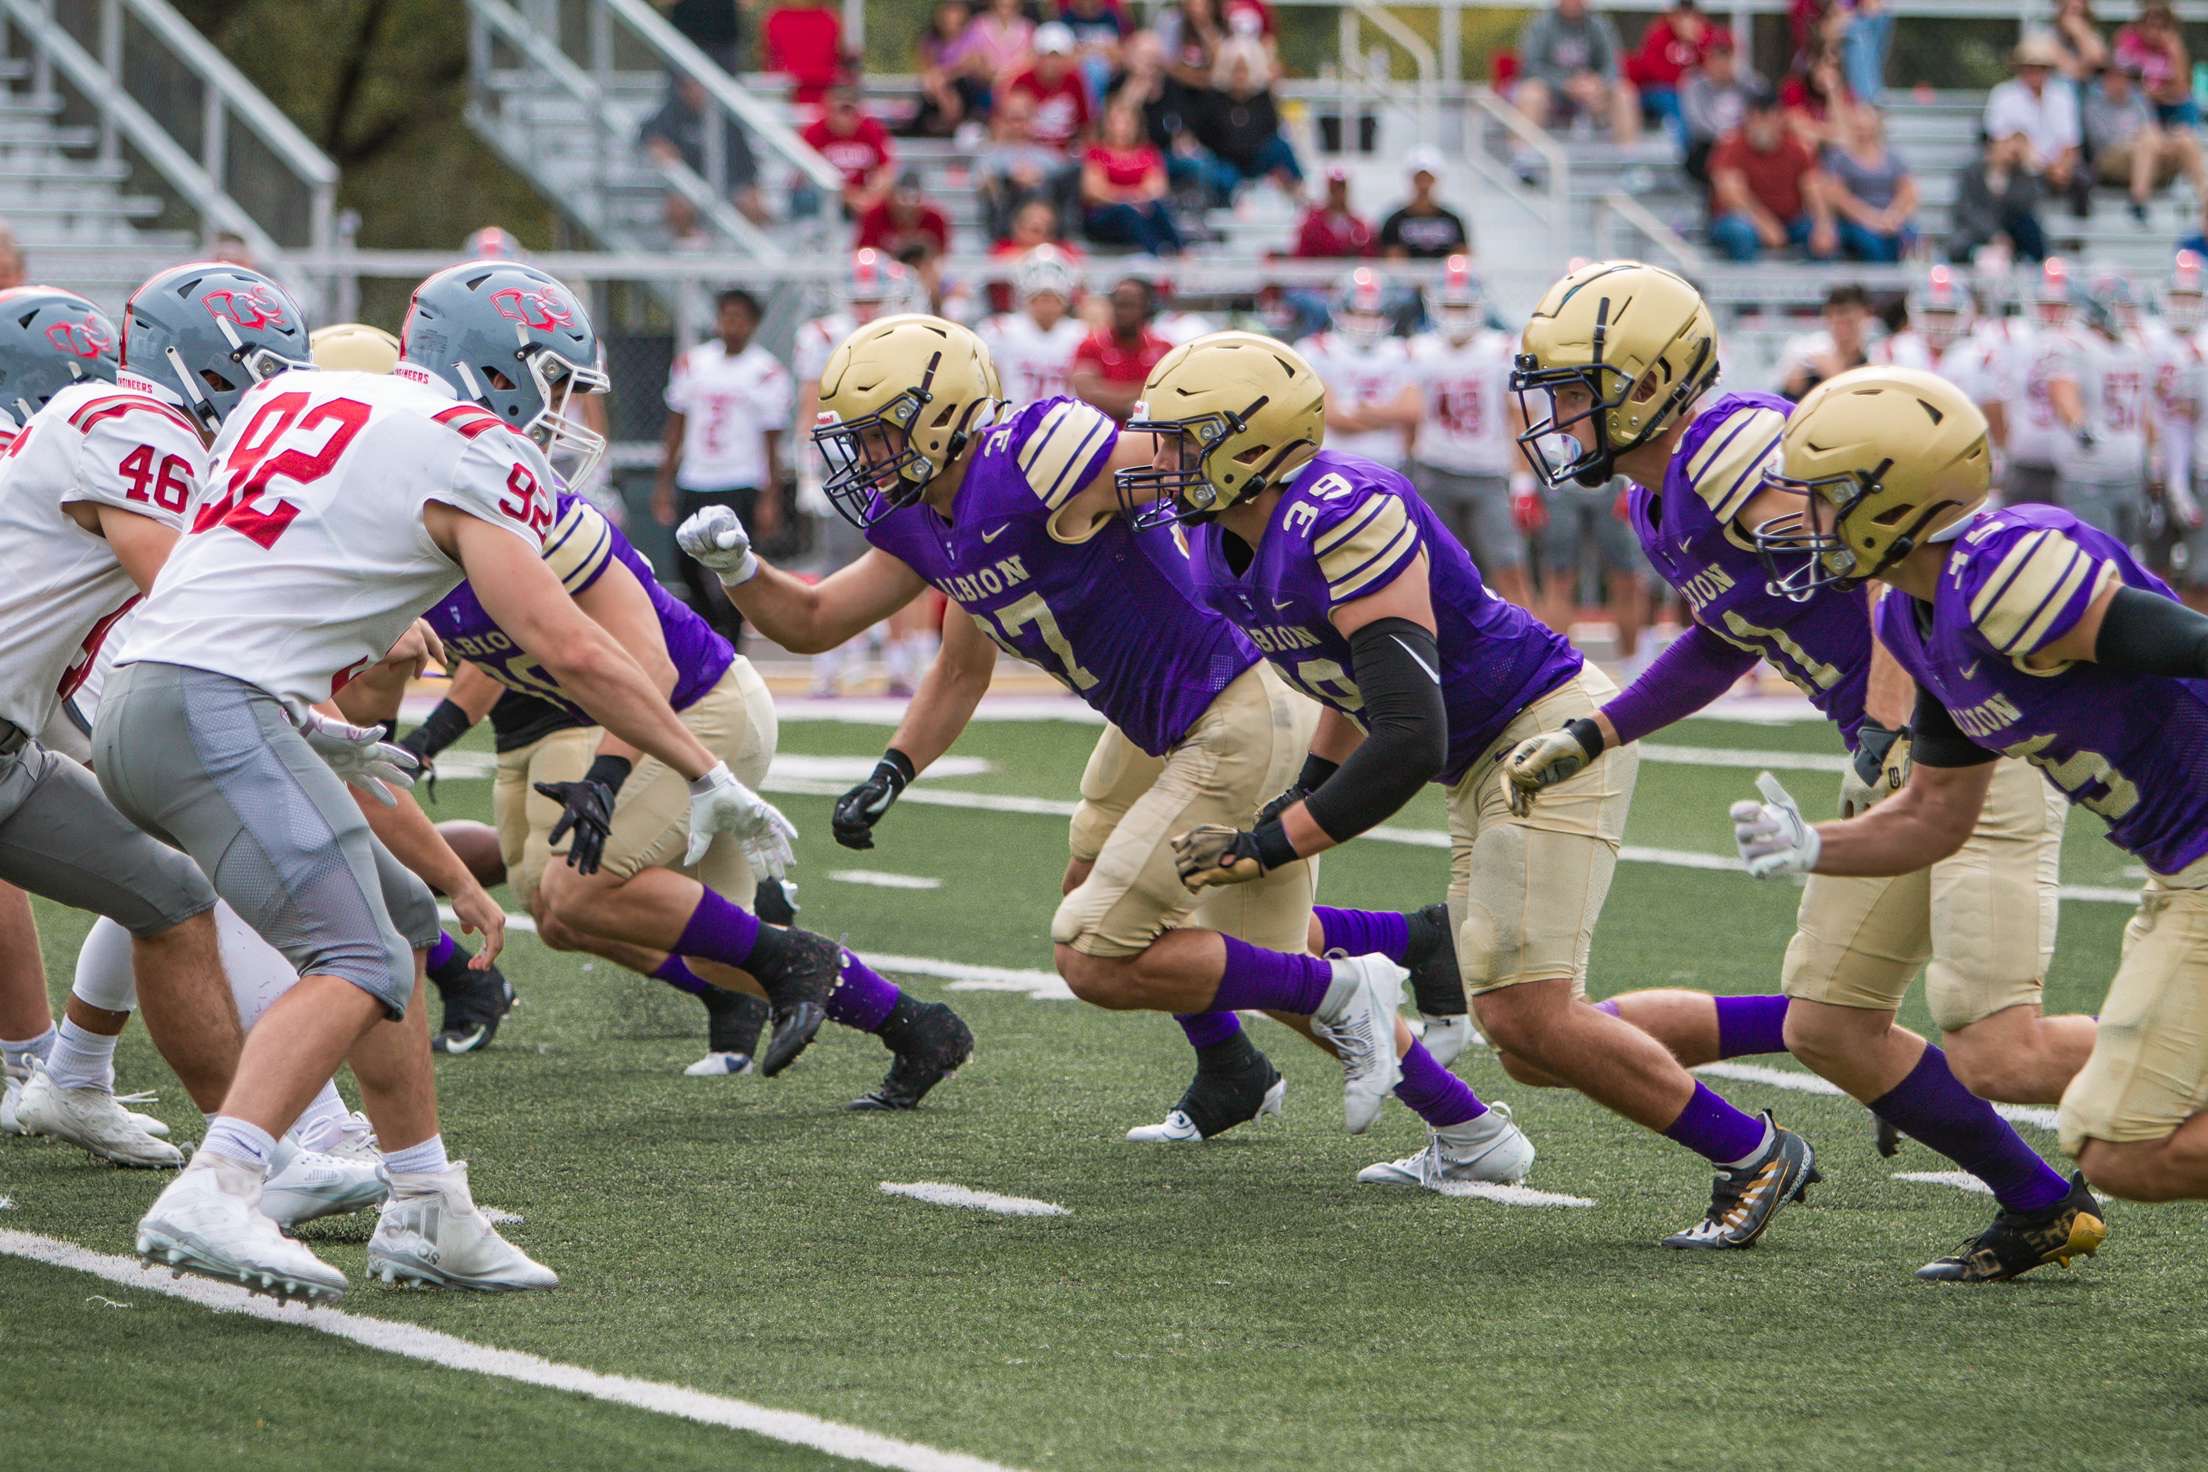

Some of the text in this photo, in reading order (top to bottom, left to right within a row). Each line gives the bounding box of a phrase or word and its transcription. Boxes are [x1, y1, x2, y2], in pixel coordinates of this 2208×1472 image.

[119, 443, 195, 515] 46
[190, 391, 373, 551] 92
[1283, 472, 1353, 539] 39
